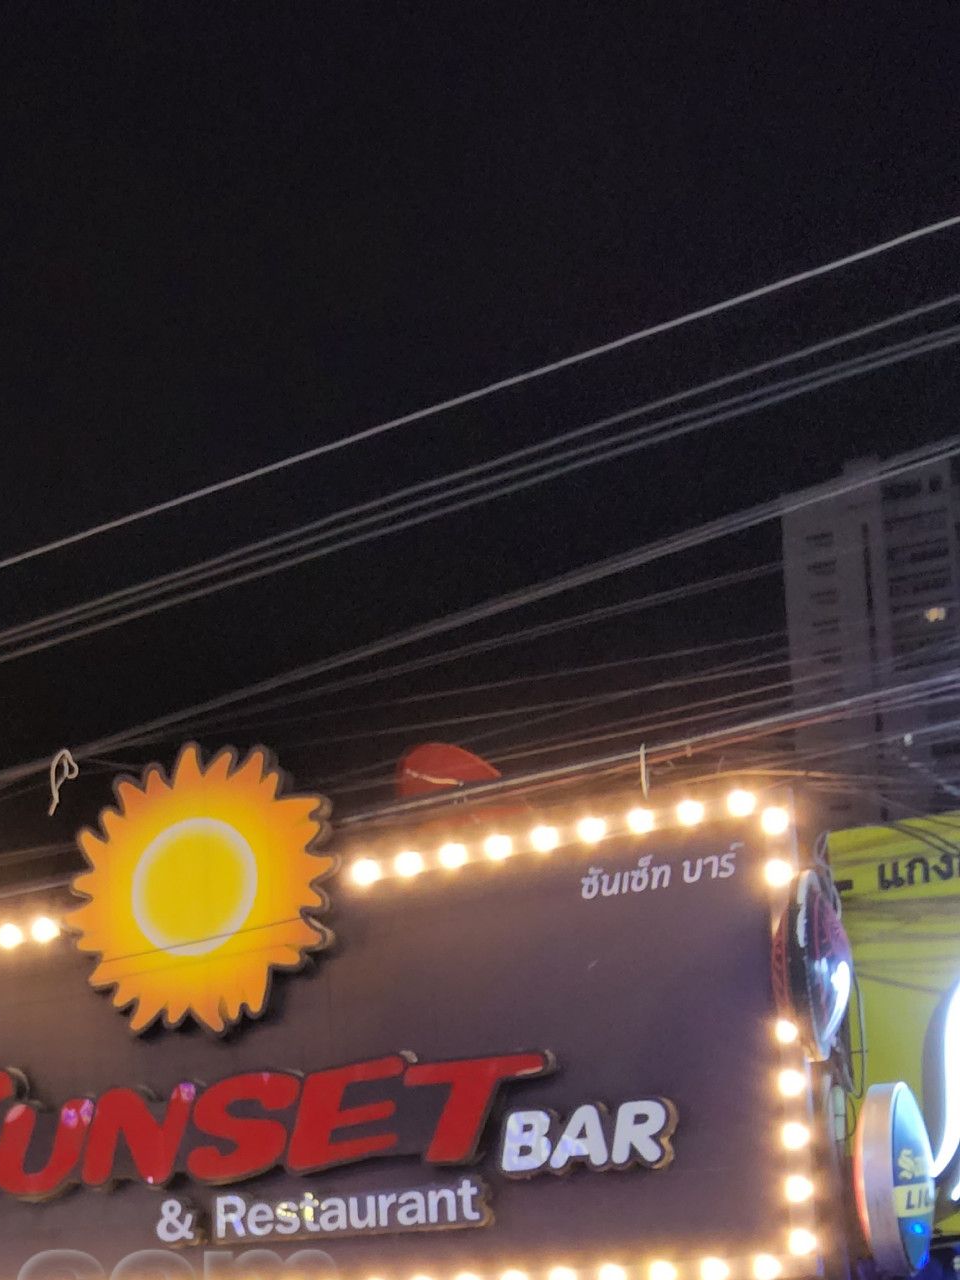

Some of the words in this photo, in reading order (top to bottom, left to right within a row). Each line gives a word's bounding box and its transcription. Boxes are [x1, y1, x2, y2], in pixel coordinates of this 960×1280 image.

[681, 841, 744, 884] บาร์
[878, 852, 960, 891] แกง
[501, 1099, 669, 1173] BAR
[155, 1198, 195, 1242] &
[214, 1178, 481, 1238] Restaurant
